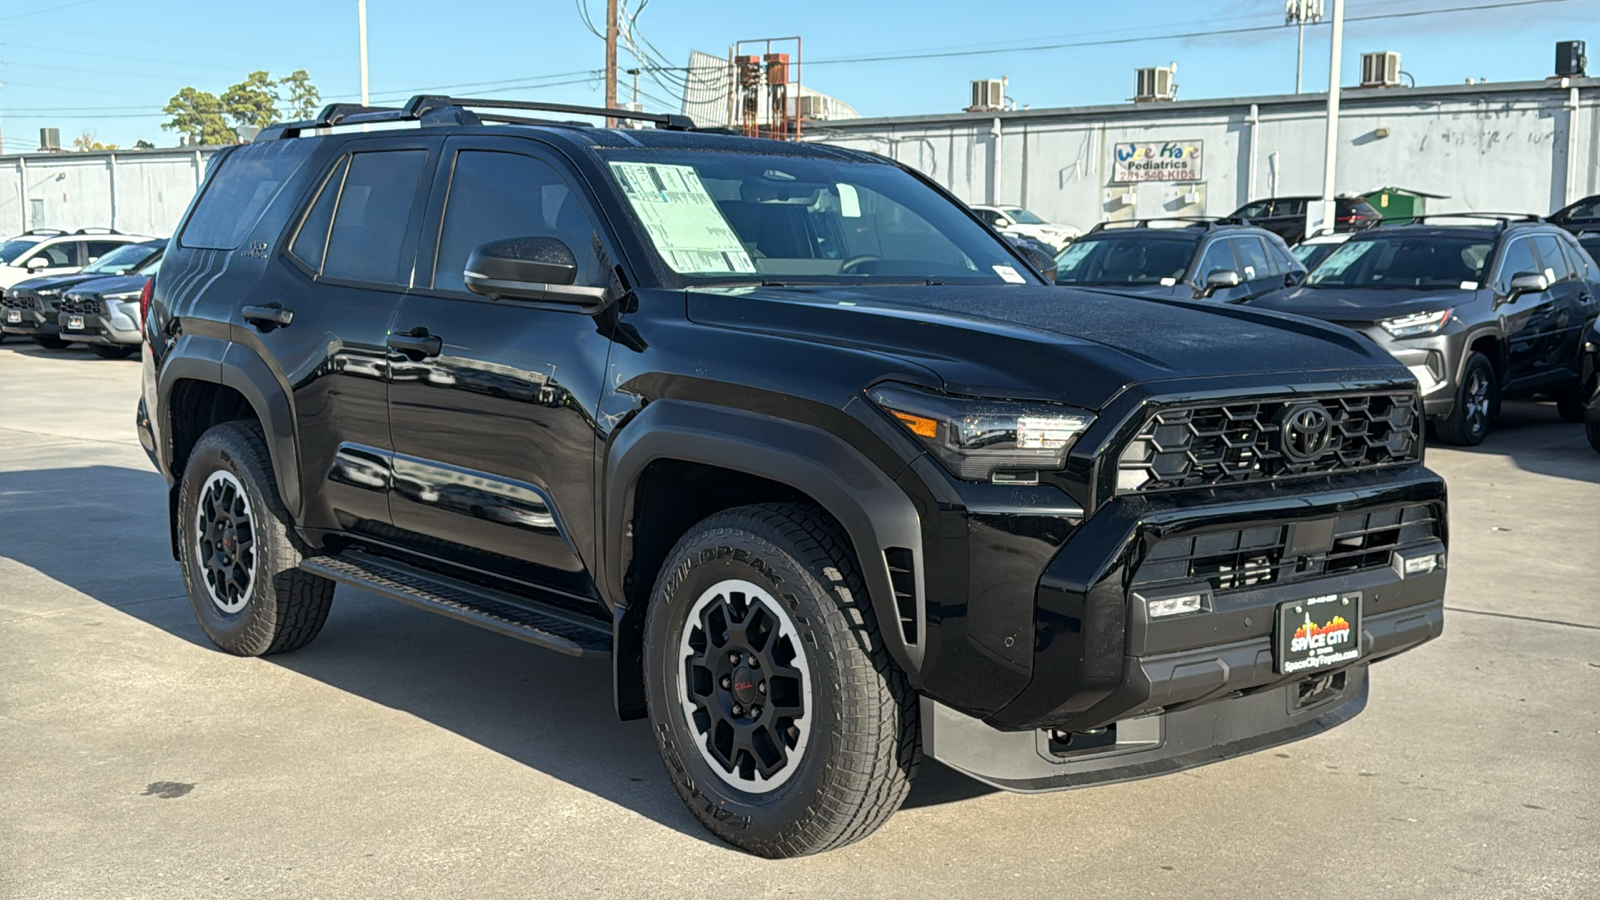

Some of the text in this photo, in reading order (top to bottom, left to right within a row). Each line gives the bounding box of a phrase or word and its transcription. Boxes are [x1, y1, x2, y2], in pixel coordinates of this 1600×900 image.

[1118, 142, 1199, 161] Wee Kare
[1120, 170, 1195, 180] 281-540-KIDS
[1128, 161, 1188, 171] Pediatrics
[1291, 628, 1350, 652] SPACE CITY
[1285, 649, 1358, 672] SpaceCityToyota.com
